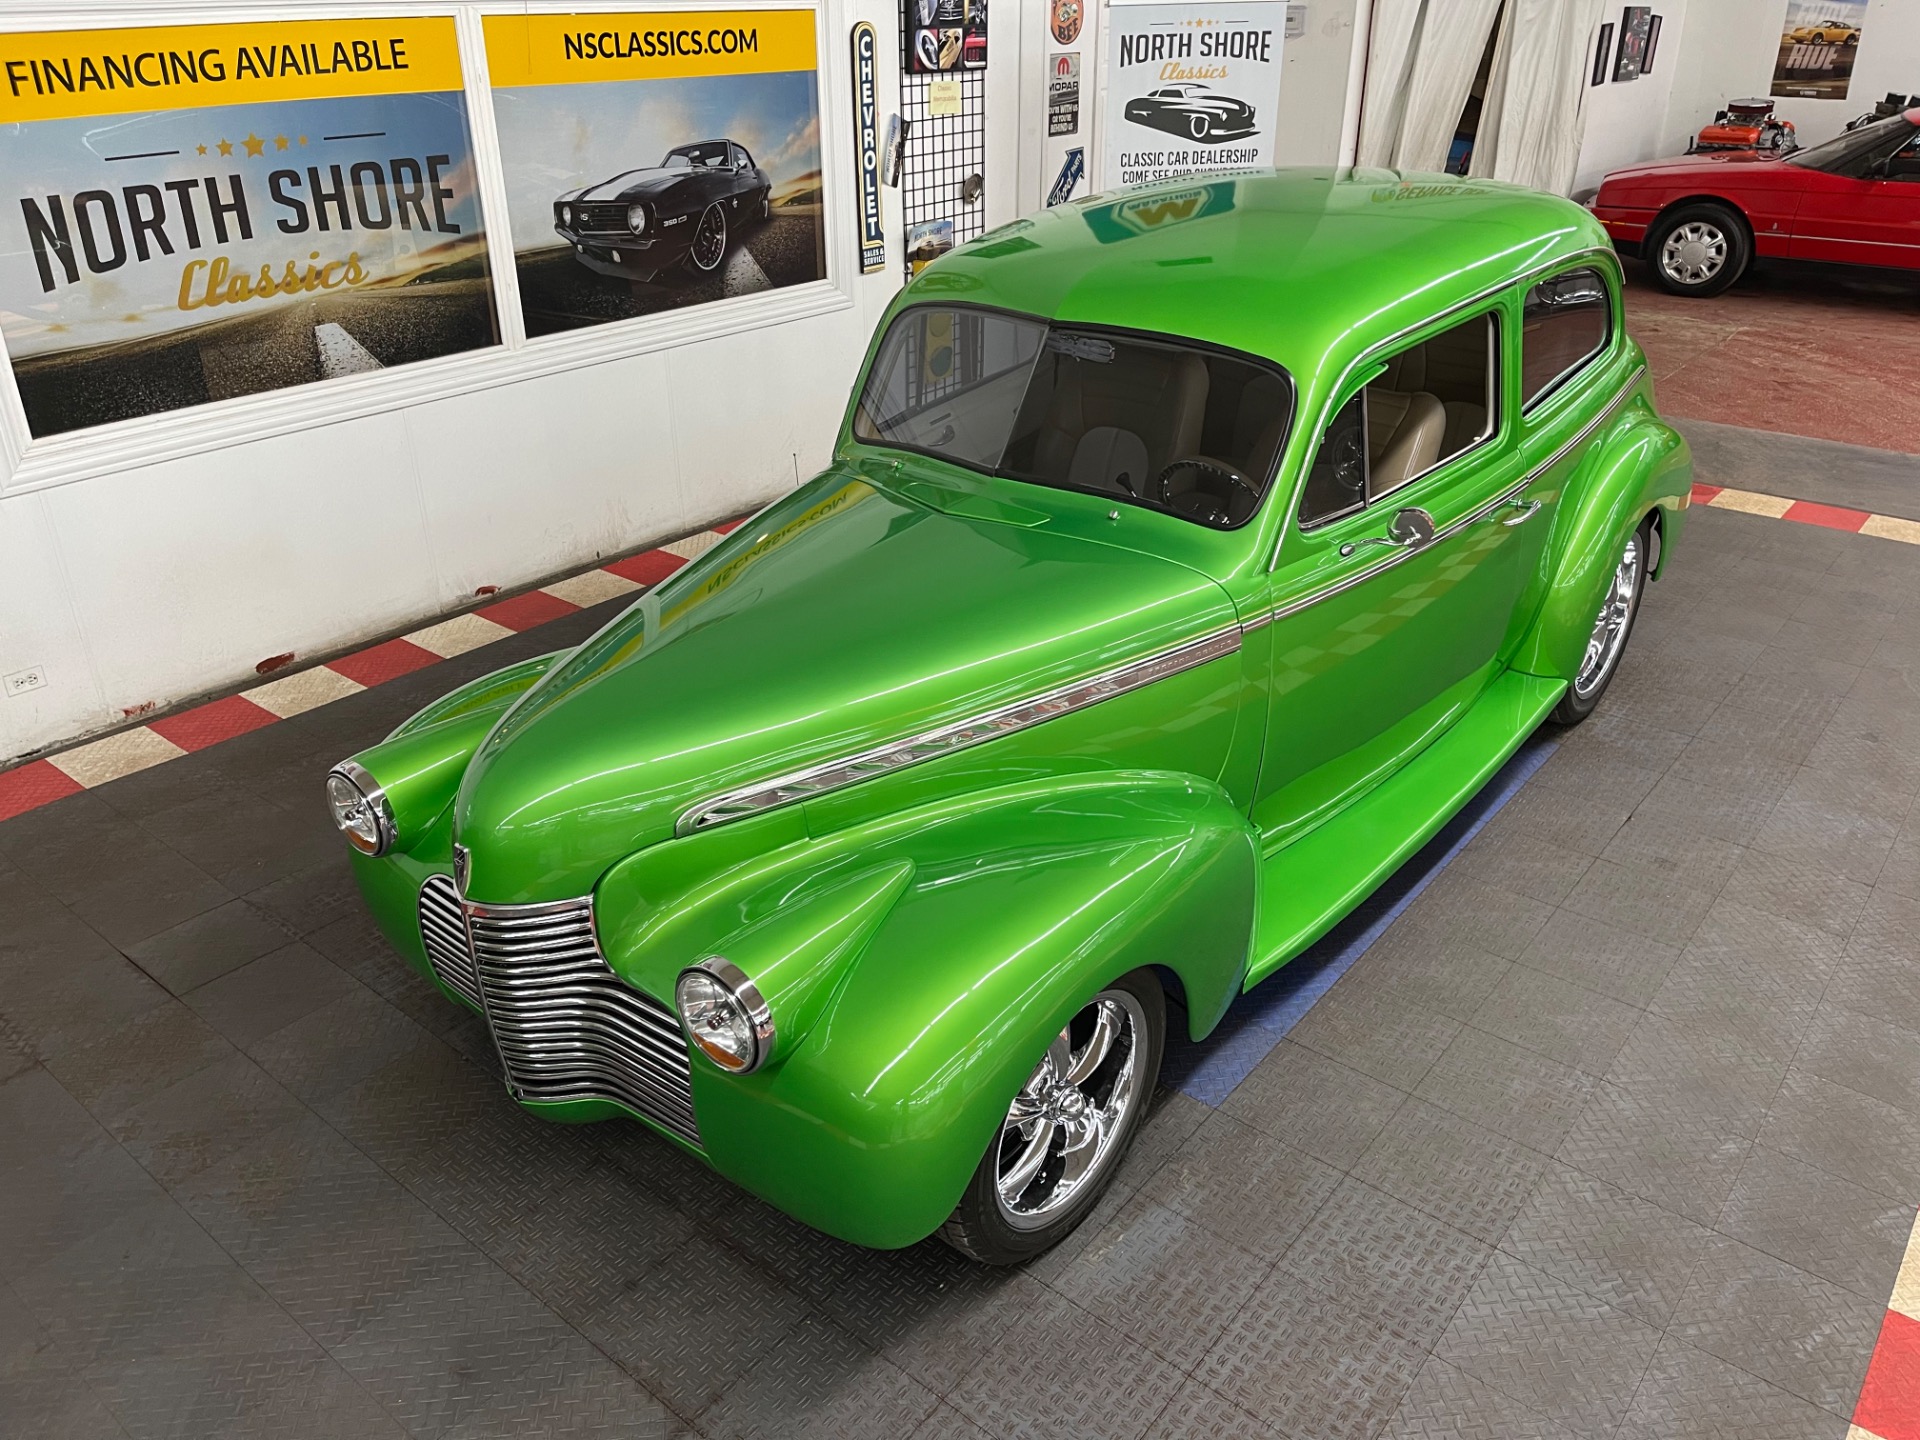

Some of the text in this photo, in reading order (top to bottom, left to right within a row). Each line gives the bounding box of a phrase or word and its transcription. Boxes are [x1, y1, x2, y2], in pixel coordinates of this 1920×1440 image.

[1057, 17, 1079, 42] BEE
[563, 28, 759, 60] NSCLASSICS.COM
[1120, 30, 1272, 68] NORTH SHORE
[1785, 43, 1838, 70] RIDE
[5, 38, 410, 97] FINANCING AVAILABLE
[1159, 61, 1230, 81] Classics
[1049, 81, 1079, 91] MOPAR
[860, 35, 878, 237] CHEVROLET
[1120, 148, 1259, 167] CLASSIC CAR DEALERSHIP
[1122, 170, 1150, 184] COME
[19, 154, 462, 293] NORTH SHORE
[663, 218, 678, 228] 350
[863, 248, 879, 258] SALES
[863, 255, 885, 266] SERVICE
[178, 250, 371, 312] Classics
